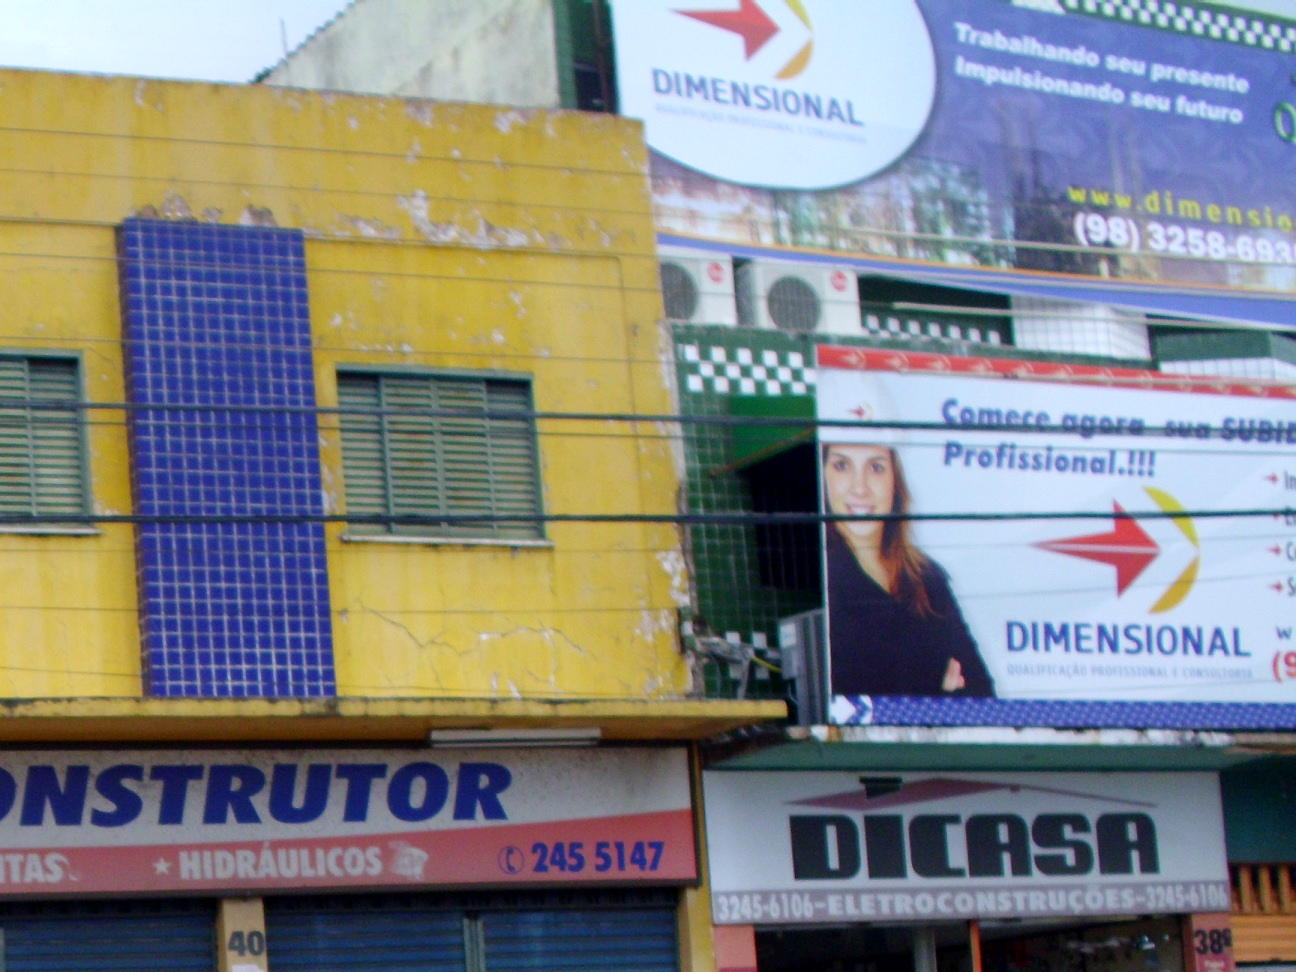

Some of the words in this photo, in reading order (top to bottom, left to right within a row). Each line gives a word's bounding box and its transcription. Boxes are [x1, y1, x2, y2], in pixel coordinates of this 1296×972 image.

[955, 21, 1101, 67] Trabalhando
[1105, 54, 1146, 76] seu
[1150, 62, 1250, 94] presente
[652, 66, 865, 127] DIMENSIONAL
[955, 55, 1125, 103] Impulsionando
[1130, 91, 1171, 113] seu
[1175, 94, 1244, 124] futuro
[1073, 211, 1141, 253] (98)
[1146, 221, 1296, 263] 3258-693
[941, 398, 1051, 428] Comece
[1062, 410, 1145, 438] agora
[1165, 419, 1211, 438] sua
[1006, 620, 1253, 658] DIMENSIONAL
[178, 842, 384, 881] HIDRÁULICOS
[530, 840, 586, 873] 245
[594, 840, 666, 873] 5147
[788, 812, 1161, 880] DICASA
[227, 930, 265, 957] 40
